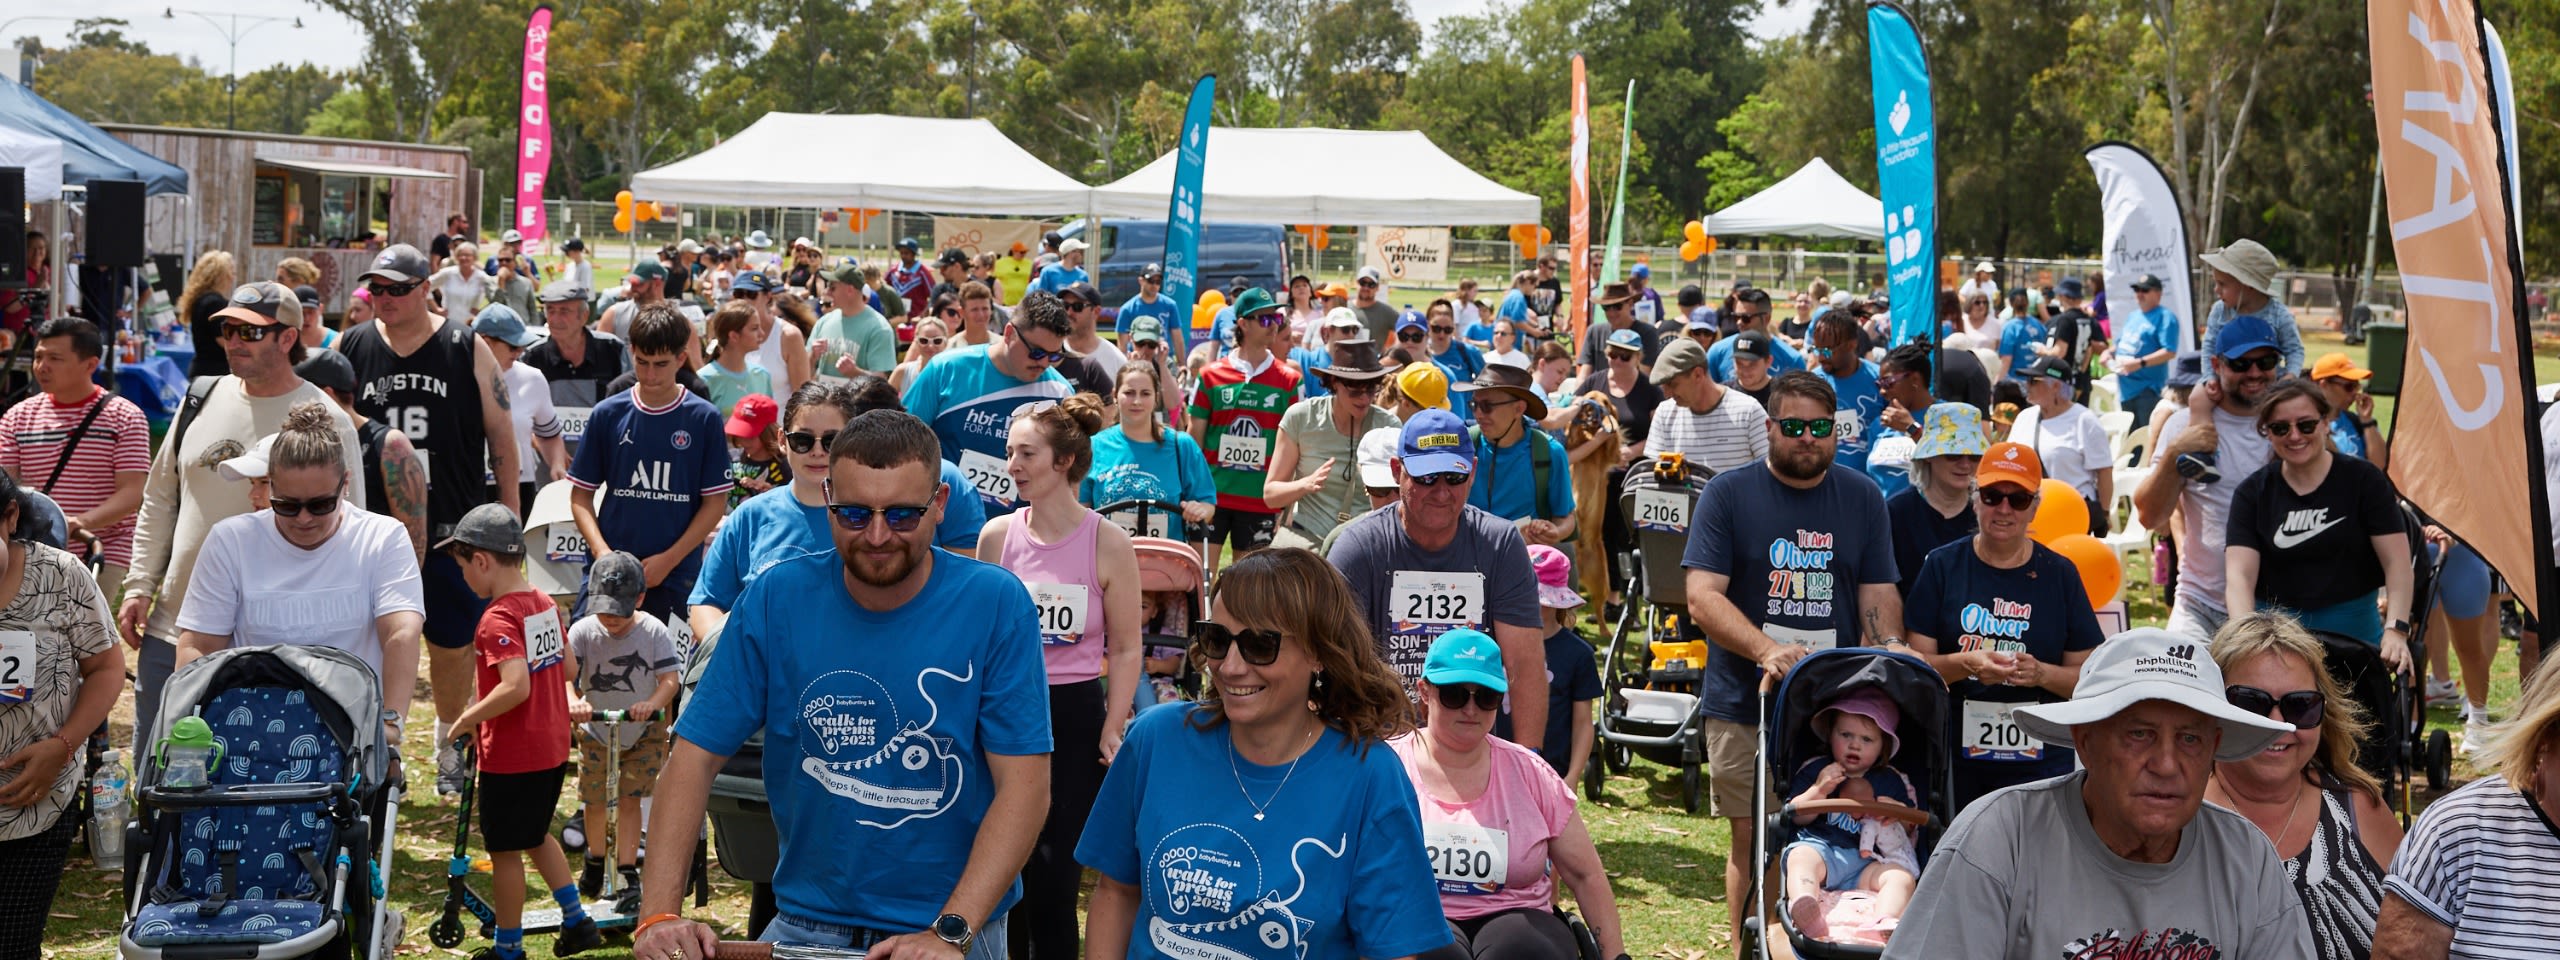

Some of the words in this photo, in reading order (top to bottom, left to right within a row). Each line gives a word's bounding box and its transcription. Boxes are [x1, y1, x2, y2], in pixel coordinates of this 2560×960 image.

[521, 71, 545, 256] COFFEE
[1384, 244, 1421, 253] walk
[1391, 254, 1438, 263] prems
[362, 373, 447, 406] AUSTIN
[385, 406, 428, 440] 16
[964, 421, 984, 434] FOR
[984, 427, 992, 436] A
[995, 428, 1009, 439] RE
[1431, 436, 1445, 446] RIVER
[1446, 434, 1459, 445] ROAD
[1224, 447, 1259, 463] 2002
[968, 468, 1010, 494] 2279
[636, 490, 651, 499] LIVE
[653, 492, 690, 502] LIMITLESS
[1643, 504, 1679, 523] 2106
[2283, 507, 2328, 531] NIKE
[1797, 529, 1833, 549] TEAM
[1769, 538, 1833, 570] Oliver
[1768, 570, 1792, 598] 27
[1807, 572, 1833, 588] 1080
[1407, 594, 1467, 619] 2132
[1767, 600, 1781, 615] 35
[1806, 602, 1832, 617] LONG
[1993, 598, 2031, 619] TEAM
[1961, 603, 2030, 639] Oliver
[535, 629, 561, 656] 2031
[1390, 650, 1399, 664] of
[2136, 656, 2197, 671] bhpbilliton
[2135, 666, 2168, 674] resourcing
[2180, 669, 2198, 679] future
[812, 714, 855, 727] walk
[858, 715, 876, 726] for
[822, 725, 876, 738] prems
[840, 734, 876, 746] 2023
[813, 765, 825, 780] Big
[825, 777, 848, 791] steps
[851, 784, 861, 795] for
[863, 789, 883, 802] little
[886, 795, 930, 806] treasures
[1426, 846, 1491, 878] 2130
[1167, 867, 1213, 886] walk
[1215, 876, 1237, 889] for
[1172, 879, 1234, 902] prems
[1192, 896, 1231, 913] 2023
[1154, 927, 1165, 945] Big
[1166, 938, 1195, 956] steps
[1197, 946, 1213, 960] for
